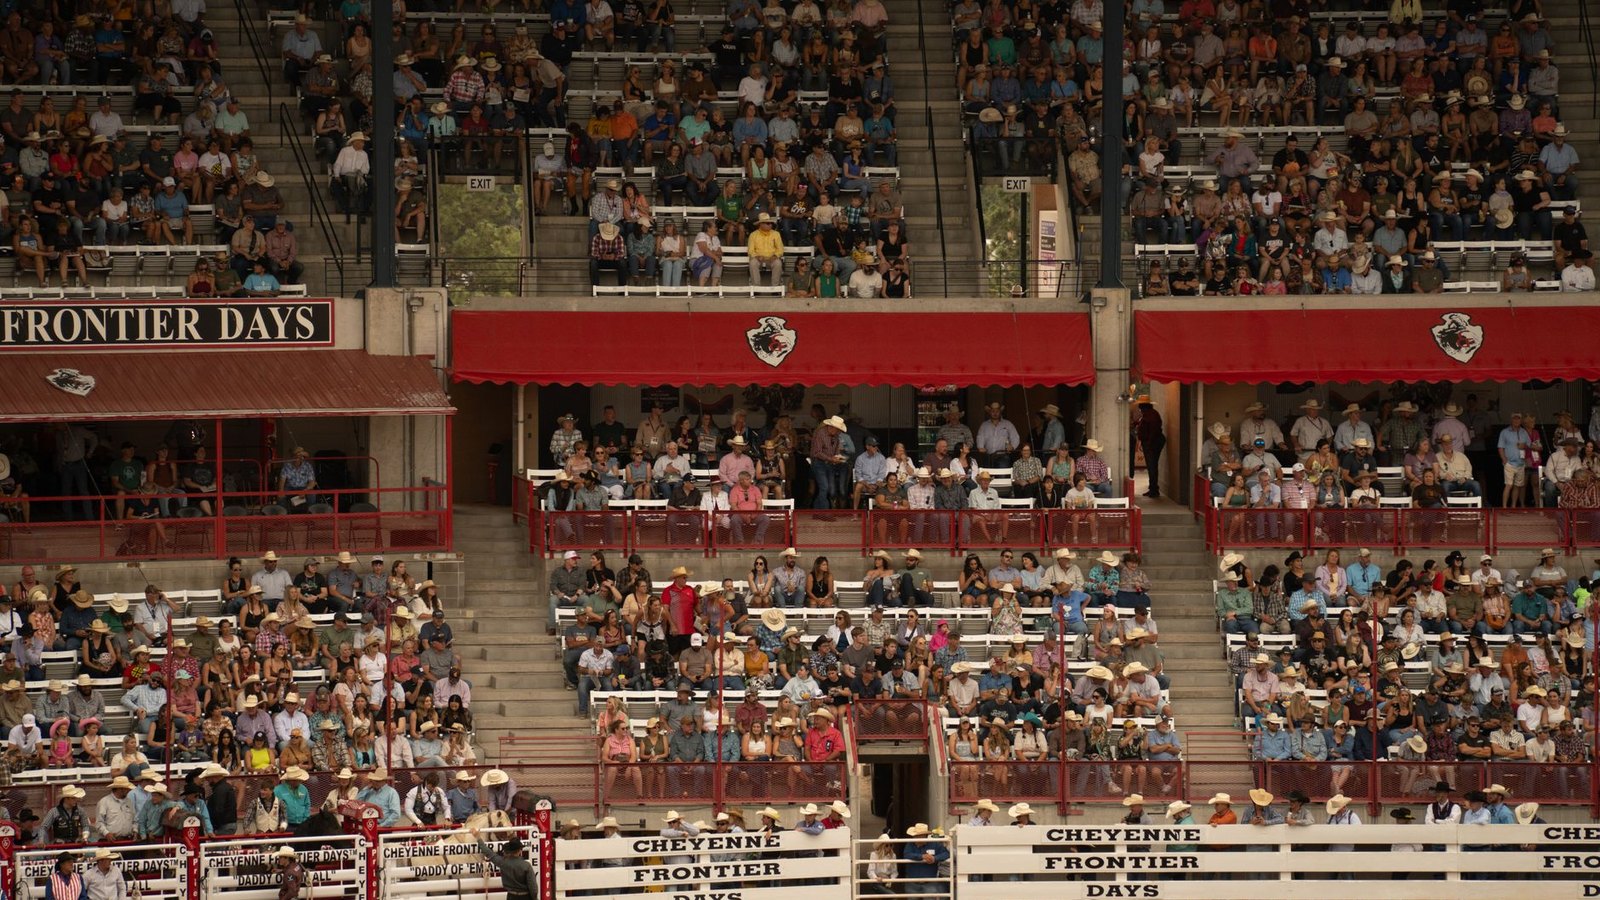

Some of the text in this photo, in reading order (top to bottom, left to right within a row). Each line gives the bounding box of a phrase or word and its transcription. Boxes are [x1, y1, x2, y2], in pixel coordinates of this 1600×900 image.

[470, 179, 491, 189] EXIT
[1006, 180, 1027, 190] EXIT
[1, 306, 315, 342] FRONTIER DAYS
[1046, 829, 1200, 841] CHEYENNE
[383, 845, 440, 859] CHEYENNE
[443, 842, 495, 856] FRONTR
[633, 835, 781, 853] CHEYENNE
[209, 854, 265, 868] CHEYENNE
[1045, 856, 1199, 869] FRONTIER
[451, 864, 463, 875] OF
[634, 863, 781, 882] FRONTIER
[1087, 885, 1159, 897] DAYS
